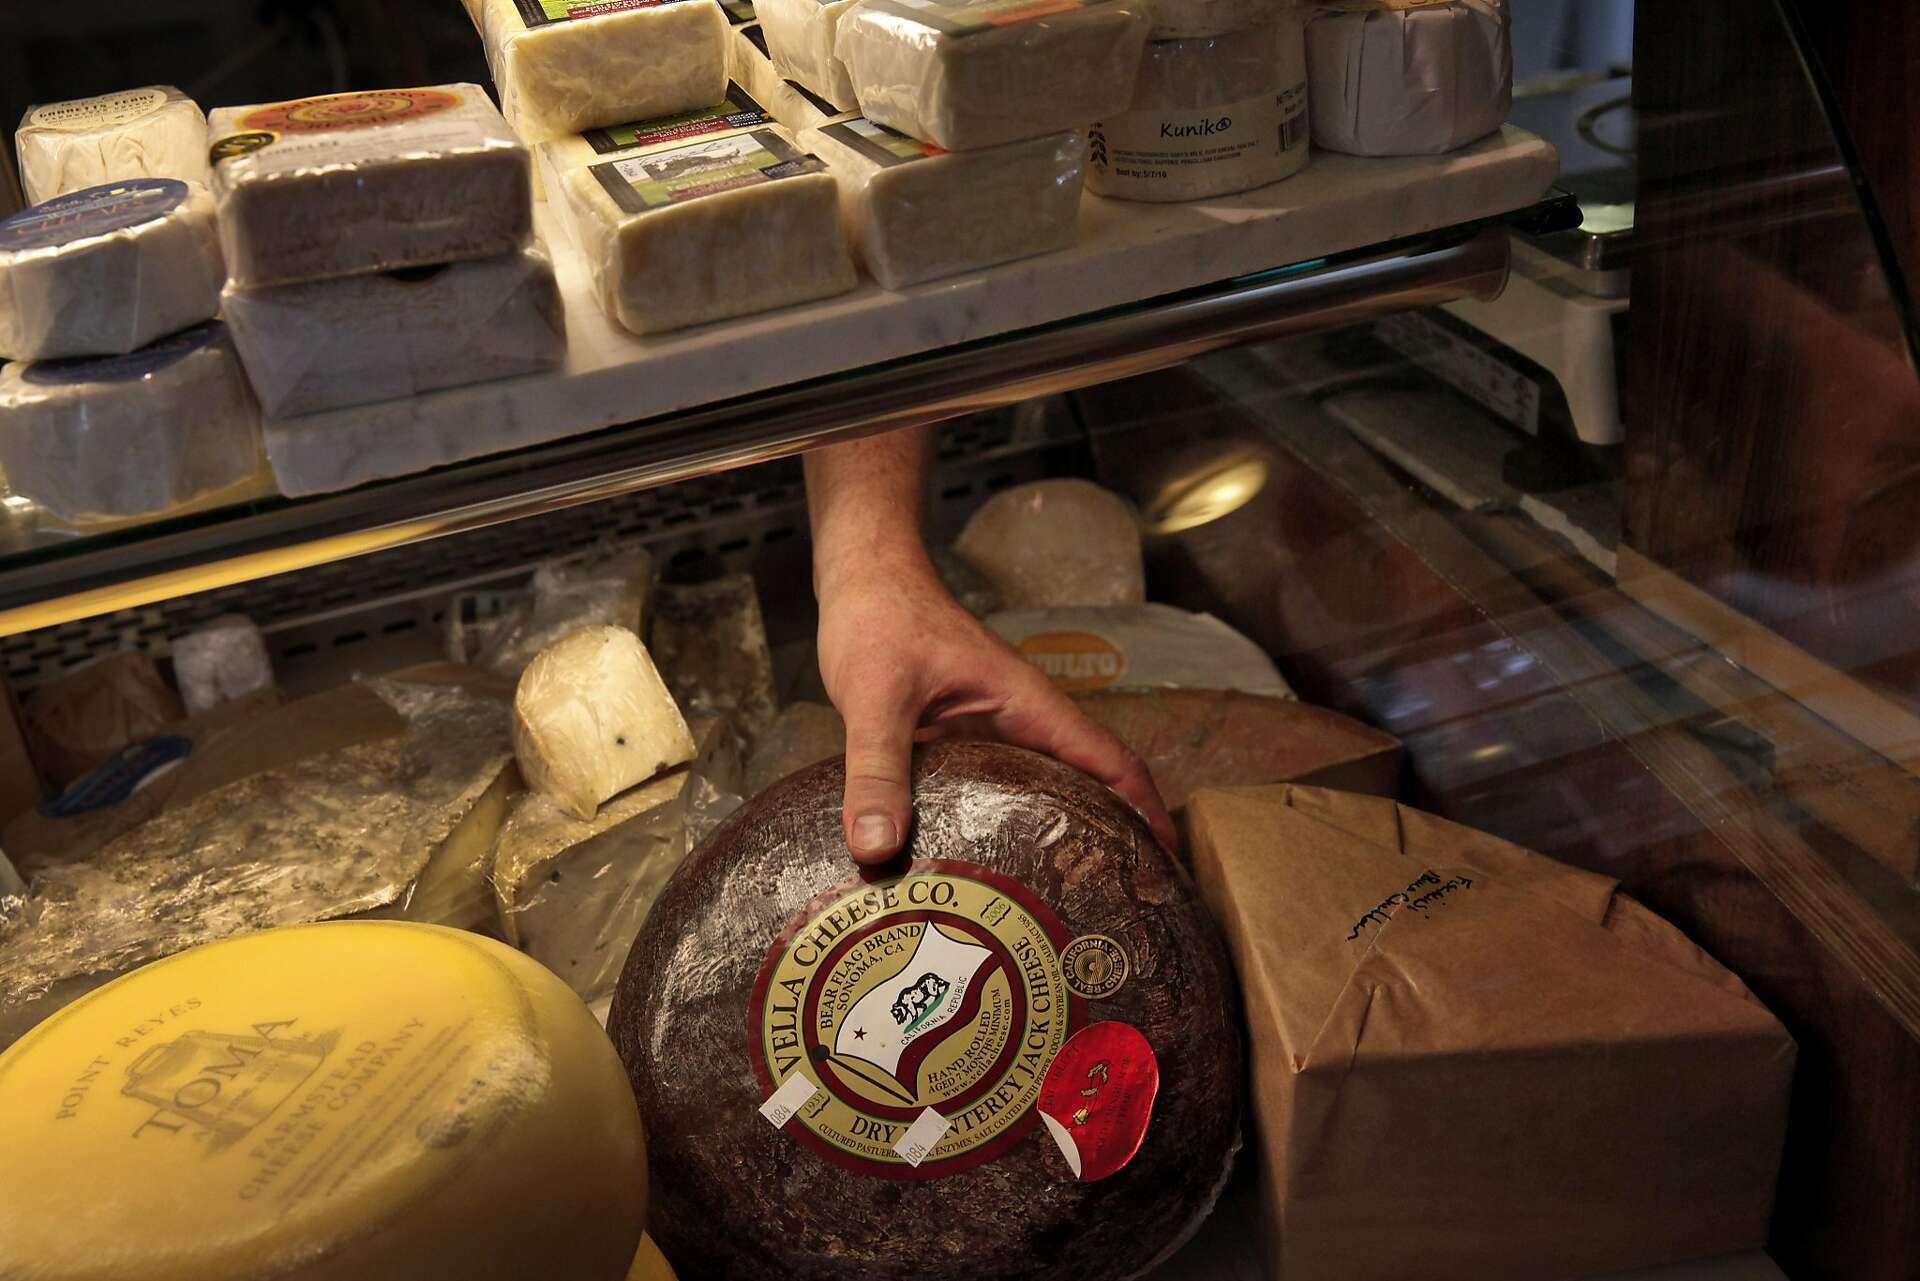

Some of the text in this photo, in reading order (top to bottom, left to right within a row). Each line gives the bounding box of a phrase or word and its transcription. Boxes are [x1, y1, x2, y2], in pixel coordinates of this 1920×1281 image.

[771, 880, 959, 1078] VELLA CHEESE CO.
[820, 925, 921, 1030] BEAR FLAG BRAND
[836, 942, 905, 1011] SONOMA, CA
[900, 976, 968, 1046] CALIFORNIA REPUBLIC
[1012, 936, 1051, 1013] CHEESE
[1064, 939, 1123, 994] REAL CALIFORNIA CHEESE
[56, 997, 203, 1121] POINT REYES
[131, 1017, 299, 1139] TOMA
[818, 1122, 857, 1149] CULTURED
[995, 1104, 1023, 1129] COATED
[1020, 1083, 1038, 1106] WITH
[1050, 1029, 1063, 1056] COCOA
[928, 1078, 956, 1094] AGED
[963, 1037, 995, 1076] MONTHS
[989, 988, 1005, 1037] MINIMUM
[928, 1010, 992, 1084] HAND ROLLED
[942, 998, 1010, 1098] www.vellacheese.com
[1016, 1016, 1051, 1080] JACK
[238, 1121, 328, 1201] CHEESE
[327, 1016, 425, 1112] COMPANY
[249, 1040, 377, 1159] FARMSTEAD
[850, 1115, 897, 1144] DRY
